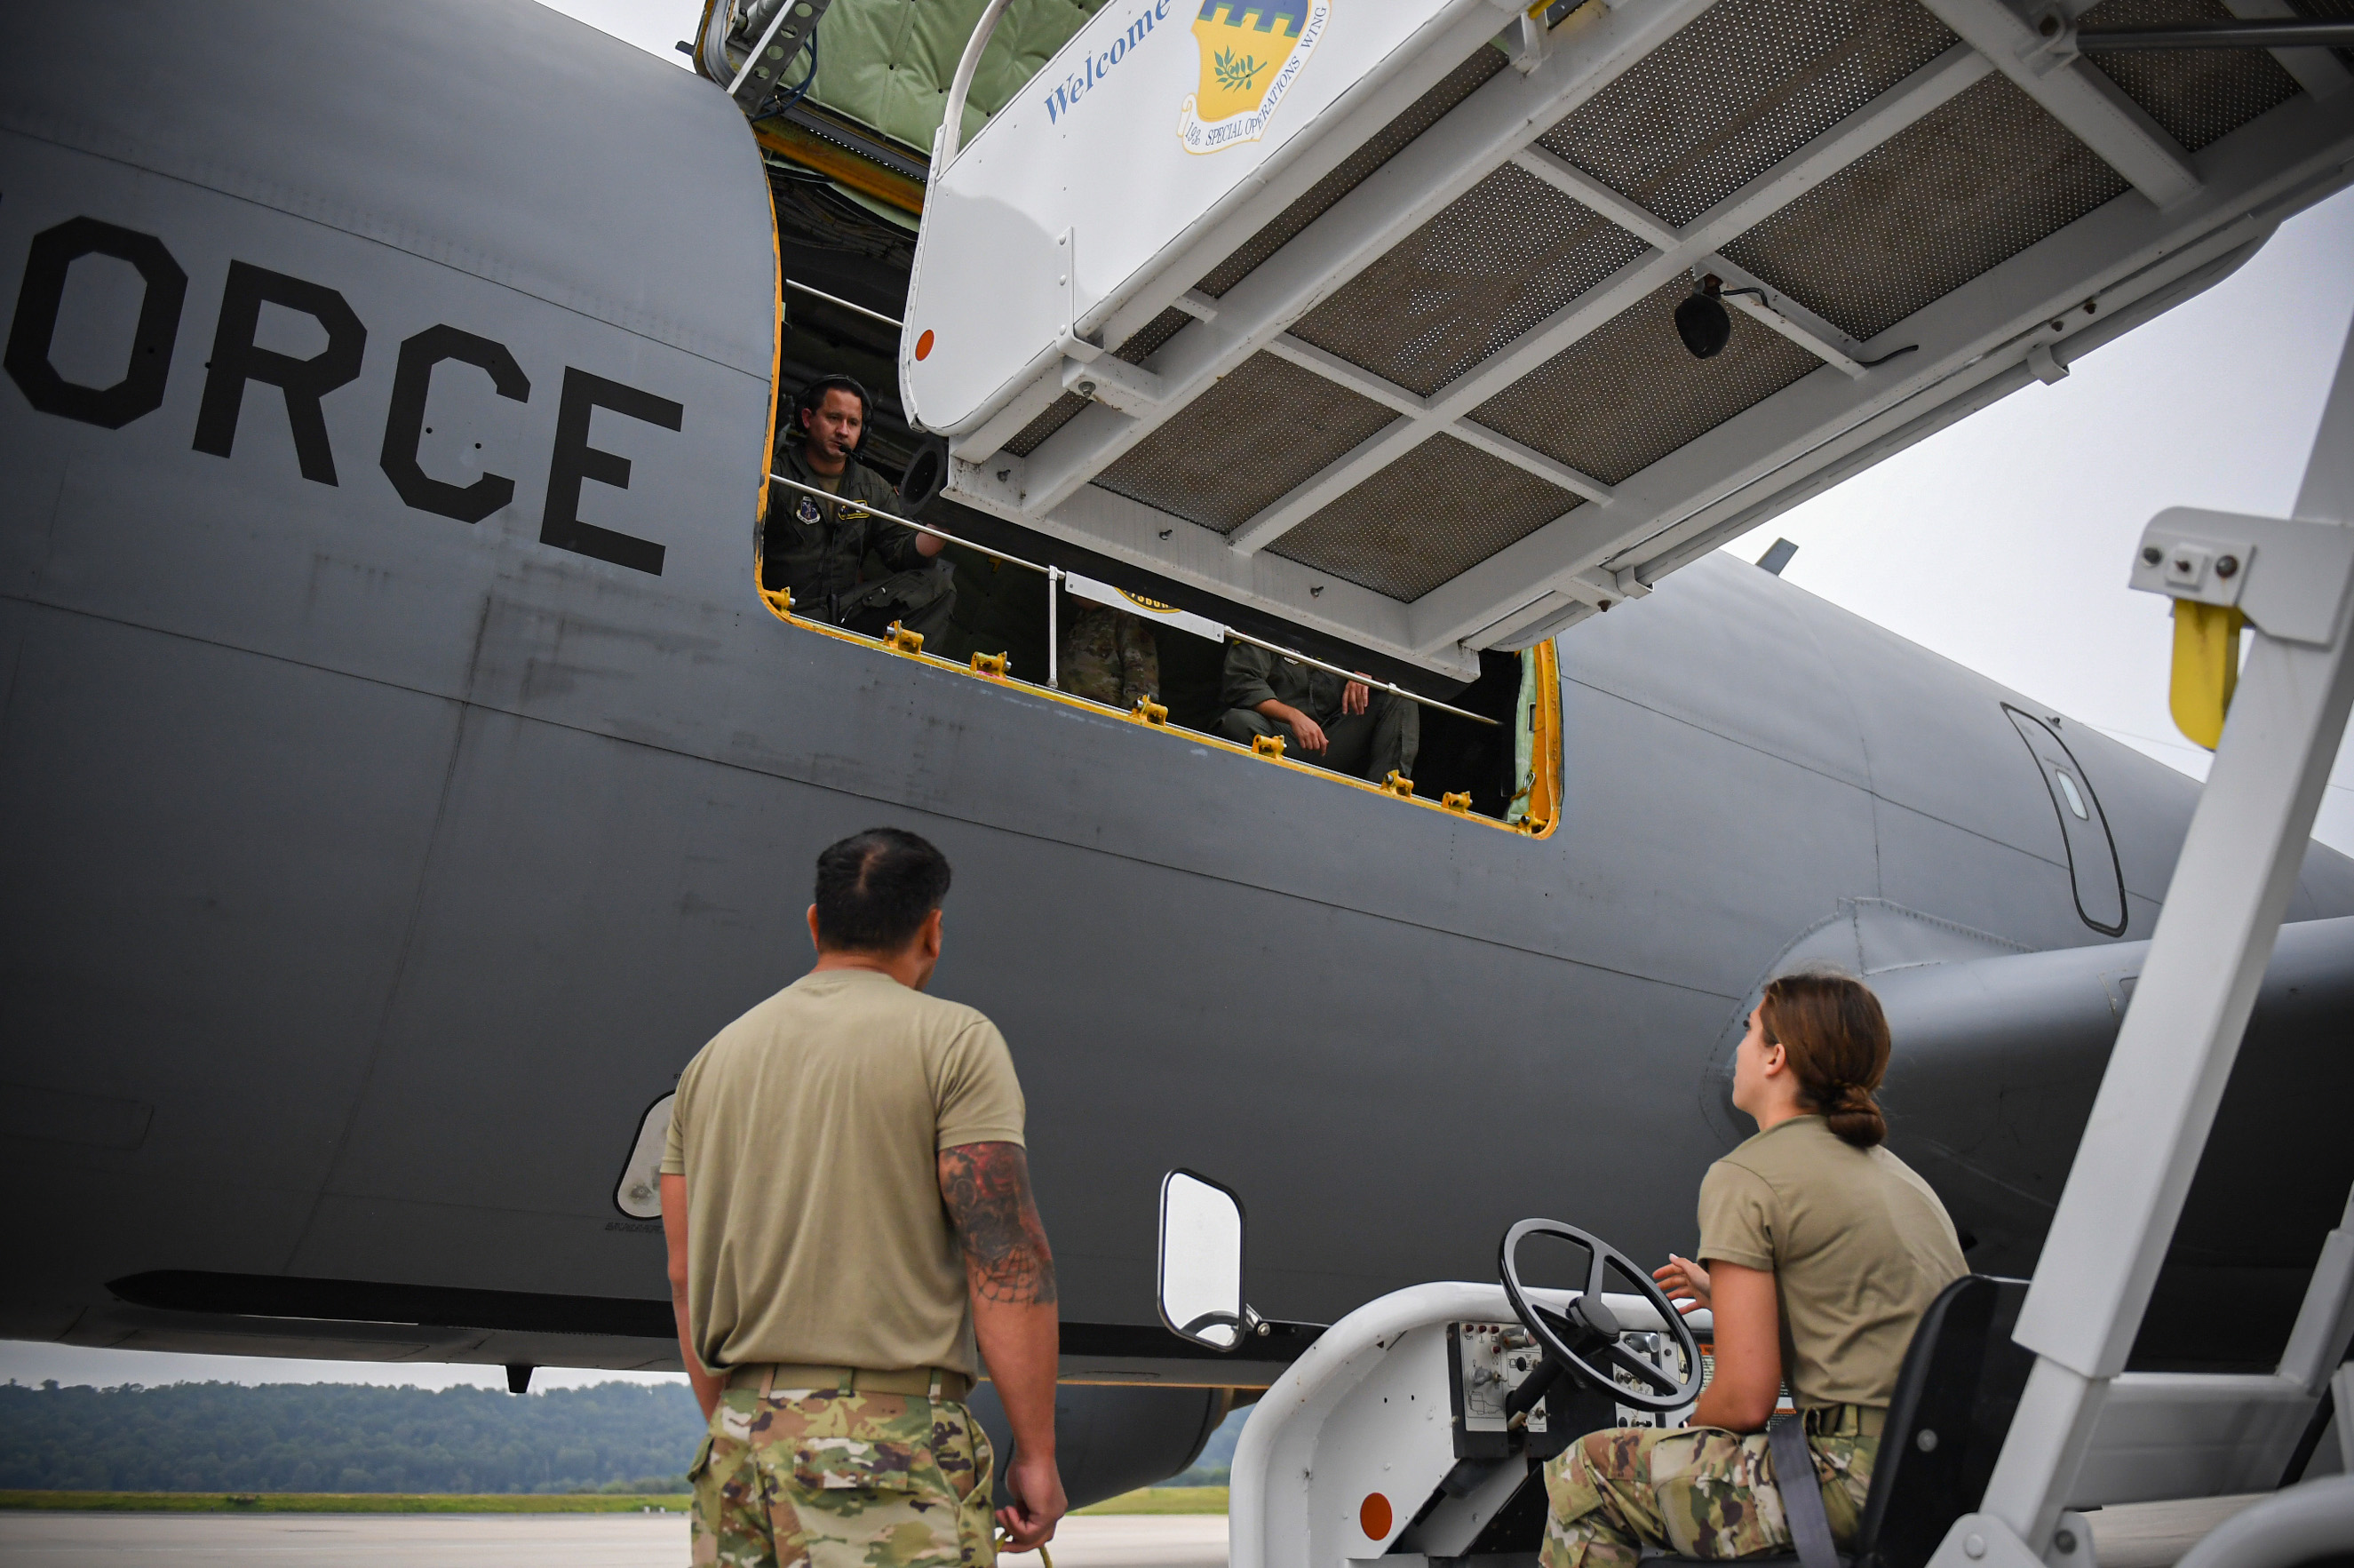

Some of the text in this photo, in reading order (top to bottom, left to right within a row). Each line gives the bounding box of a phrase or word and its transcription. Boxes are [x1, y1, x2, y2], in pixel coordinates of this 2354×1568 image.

[1044, 0, 1171, 125] Welcome
[1205, 120, 1244, 146] SPECIAL
[1245, 55, 1300, 135] OPERATIONS
[1300, 6, 1327, 49] WING
[0, 214, 684, 577] ORCE
